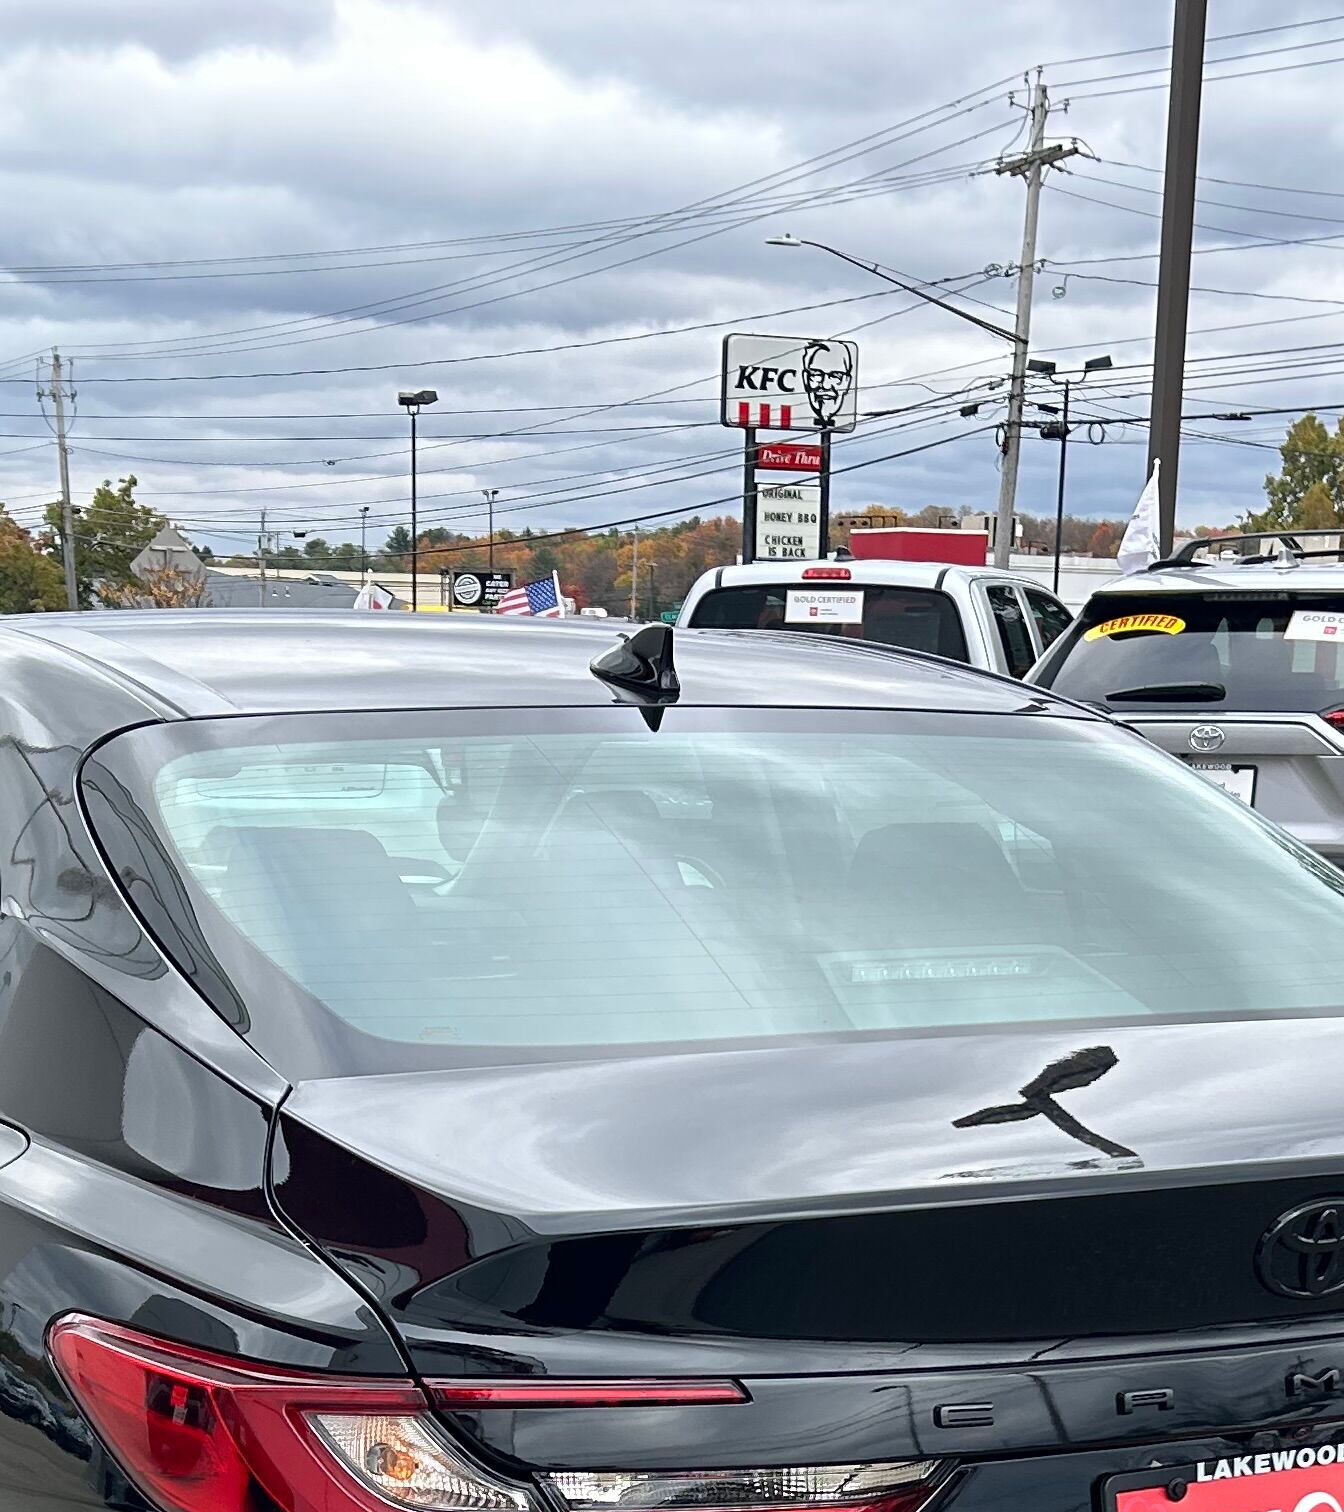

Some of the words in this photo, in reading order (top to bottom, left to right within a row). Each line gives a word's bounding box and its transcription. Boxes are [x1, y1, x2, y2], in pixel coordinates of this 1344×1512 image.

[735, 365, 797, 393] KFC
[762, 449, 792, 464] Drive
[795, 451, 821, 465] Thru
[762, 489, 803, 500] ORIGINAL
[764, 512, 792, 522] HONEY
[798, 513, 817, 523] BBQ
[765, 535, 803, 546] CHICKEN
[769, 547, 777, 556] IS
[782, 548, 806, 557] BACK
[818, 596, 856, 604] CERTIFIED
[1099, 615, 1178, 633] CERTIFIED
[1302, 615, 1336, 623] GOLD
